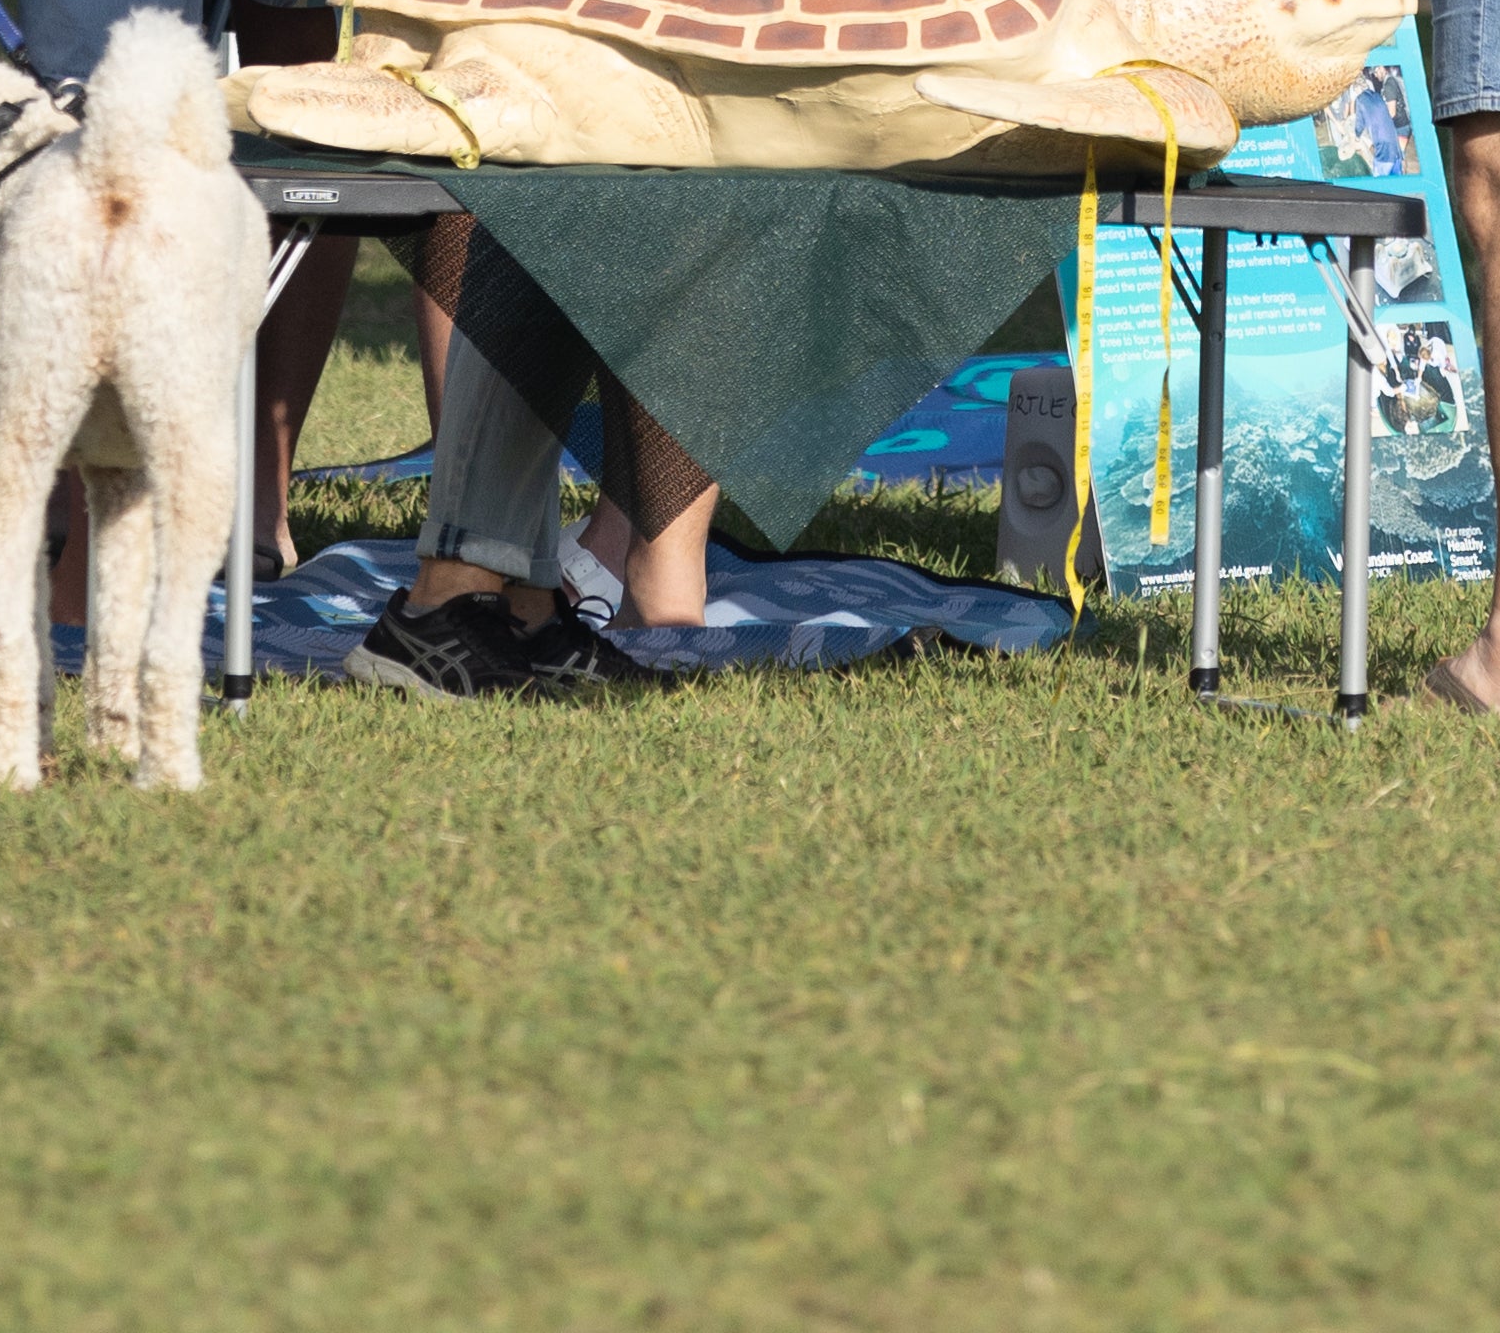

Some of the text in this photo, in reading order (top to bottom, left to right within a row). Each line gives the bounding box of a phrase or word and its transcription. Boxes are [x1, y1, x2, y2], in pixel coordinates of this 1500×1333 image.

[1444, 526, 1457, 538] Our
[1447, 537, 1487, 554] Healthy.
[1449, 552, 1482, 568] Smart.
